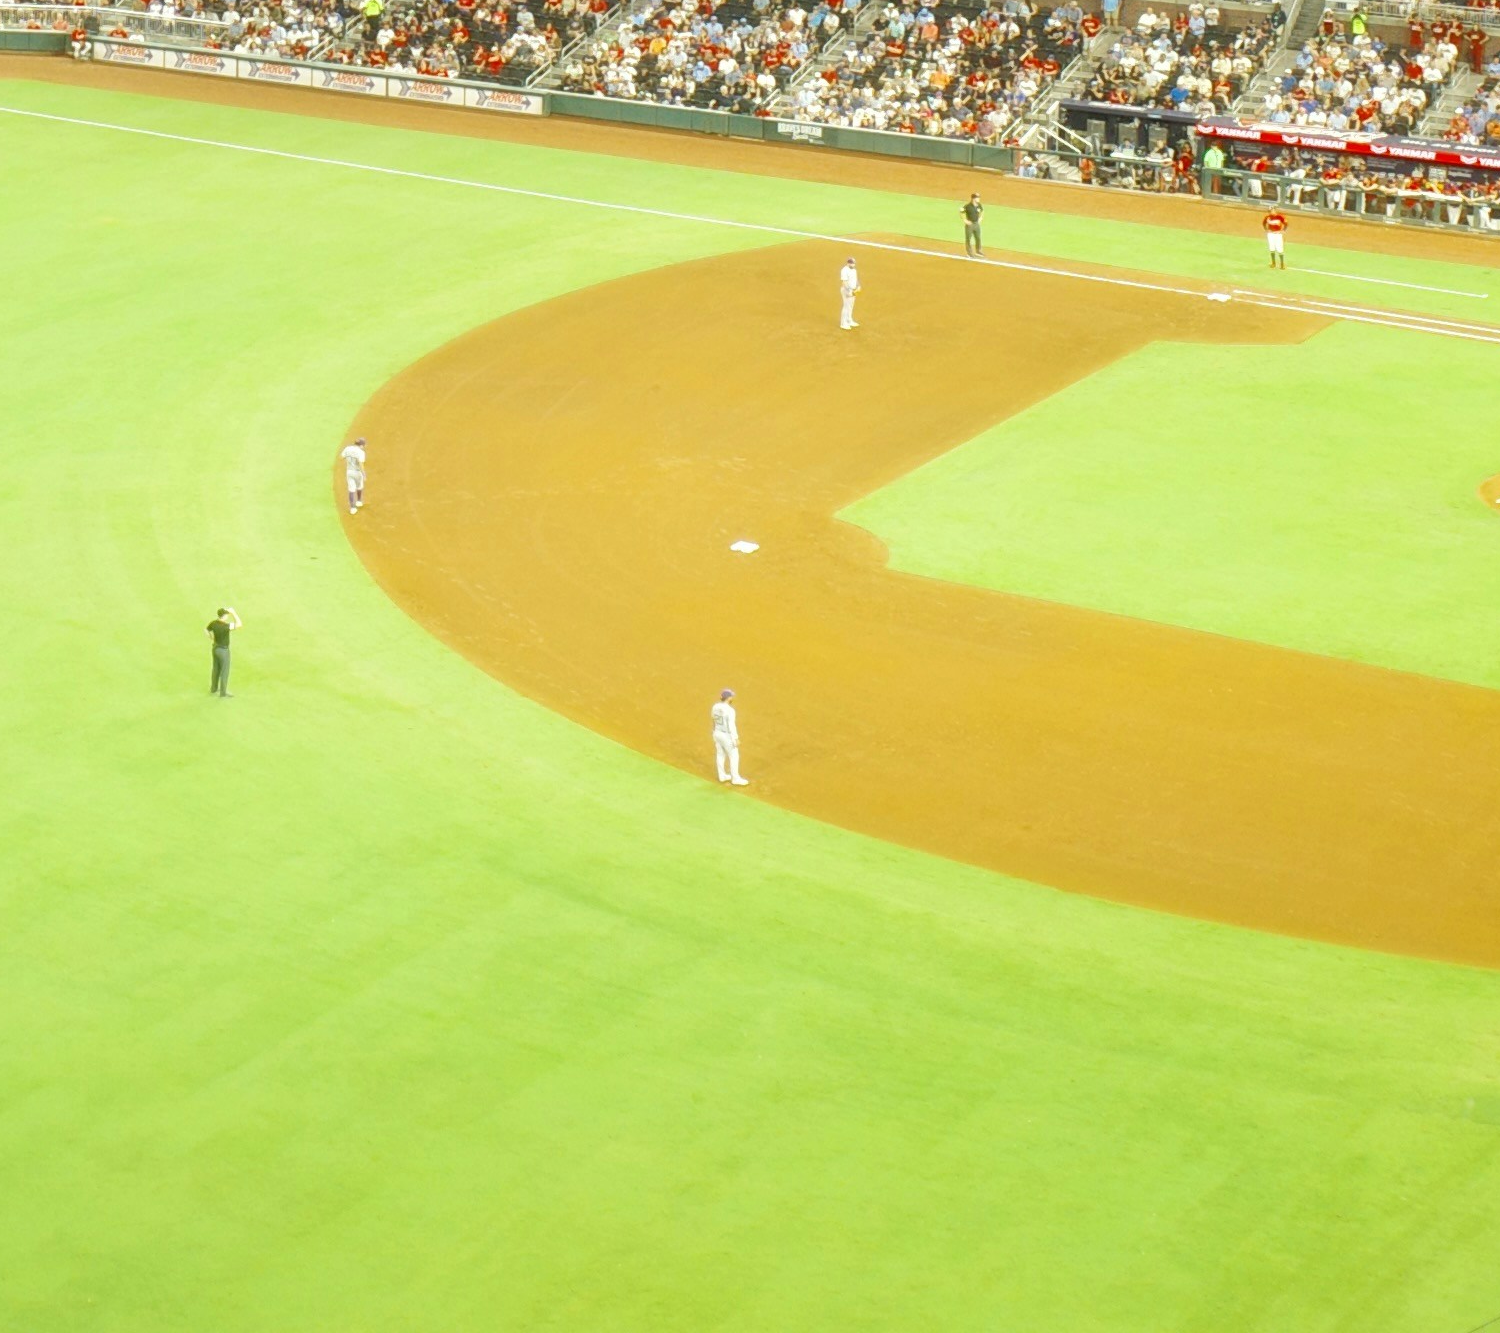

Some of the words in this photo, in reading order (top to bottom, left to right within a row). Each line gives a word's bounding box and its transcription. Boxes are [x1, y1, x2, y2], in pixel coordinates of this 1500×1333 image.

[411, 82, 444, 95] ARROW
[489, 91, 523, 103] ARROW
[1216, 127, 1260, 140] YANMAR
[1301, 137, 1347, 149] YANMAR
[1389, 147, 1436, 159] YANMAR
